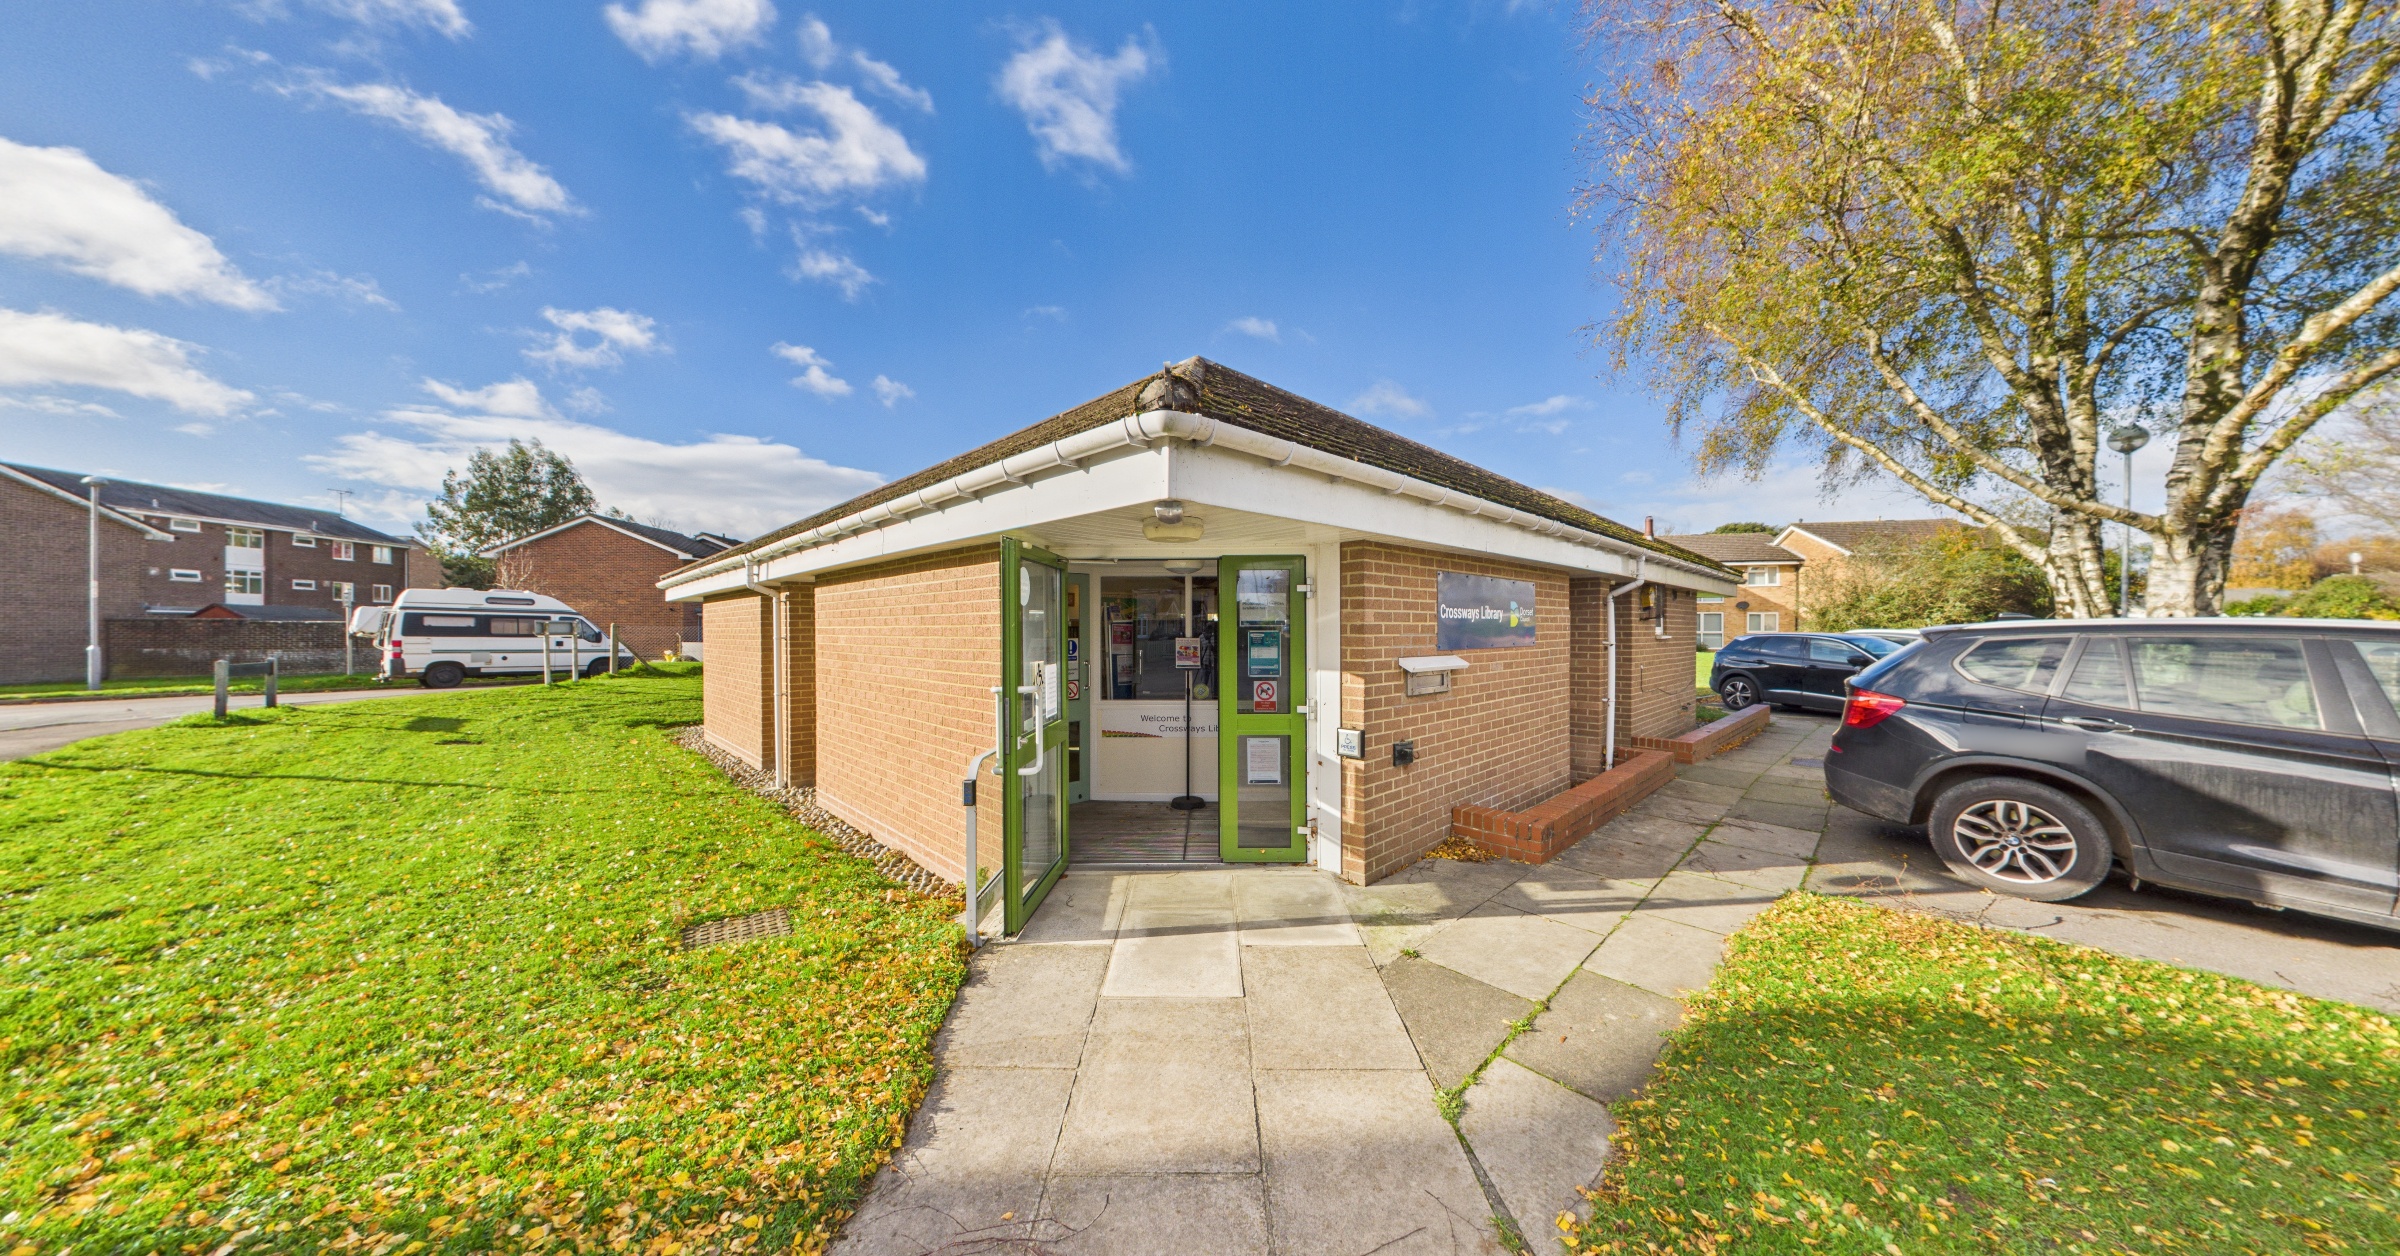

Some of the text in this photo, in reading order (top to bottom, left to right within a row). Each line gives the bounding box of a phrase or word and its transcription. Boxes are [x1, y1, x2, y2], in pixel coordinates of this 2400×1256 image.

[1440, 604, 1503, 622] Crossways Library
[1520, 607, 1534, 616] Dorset
